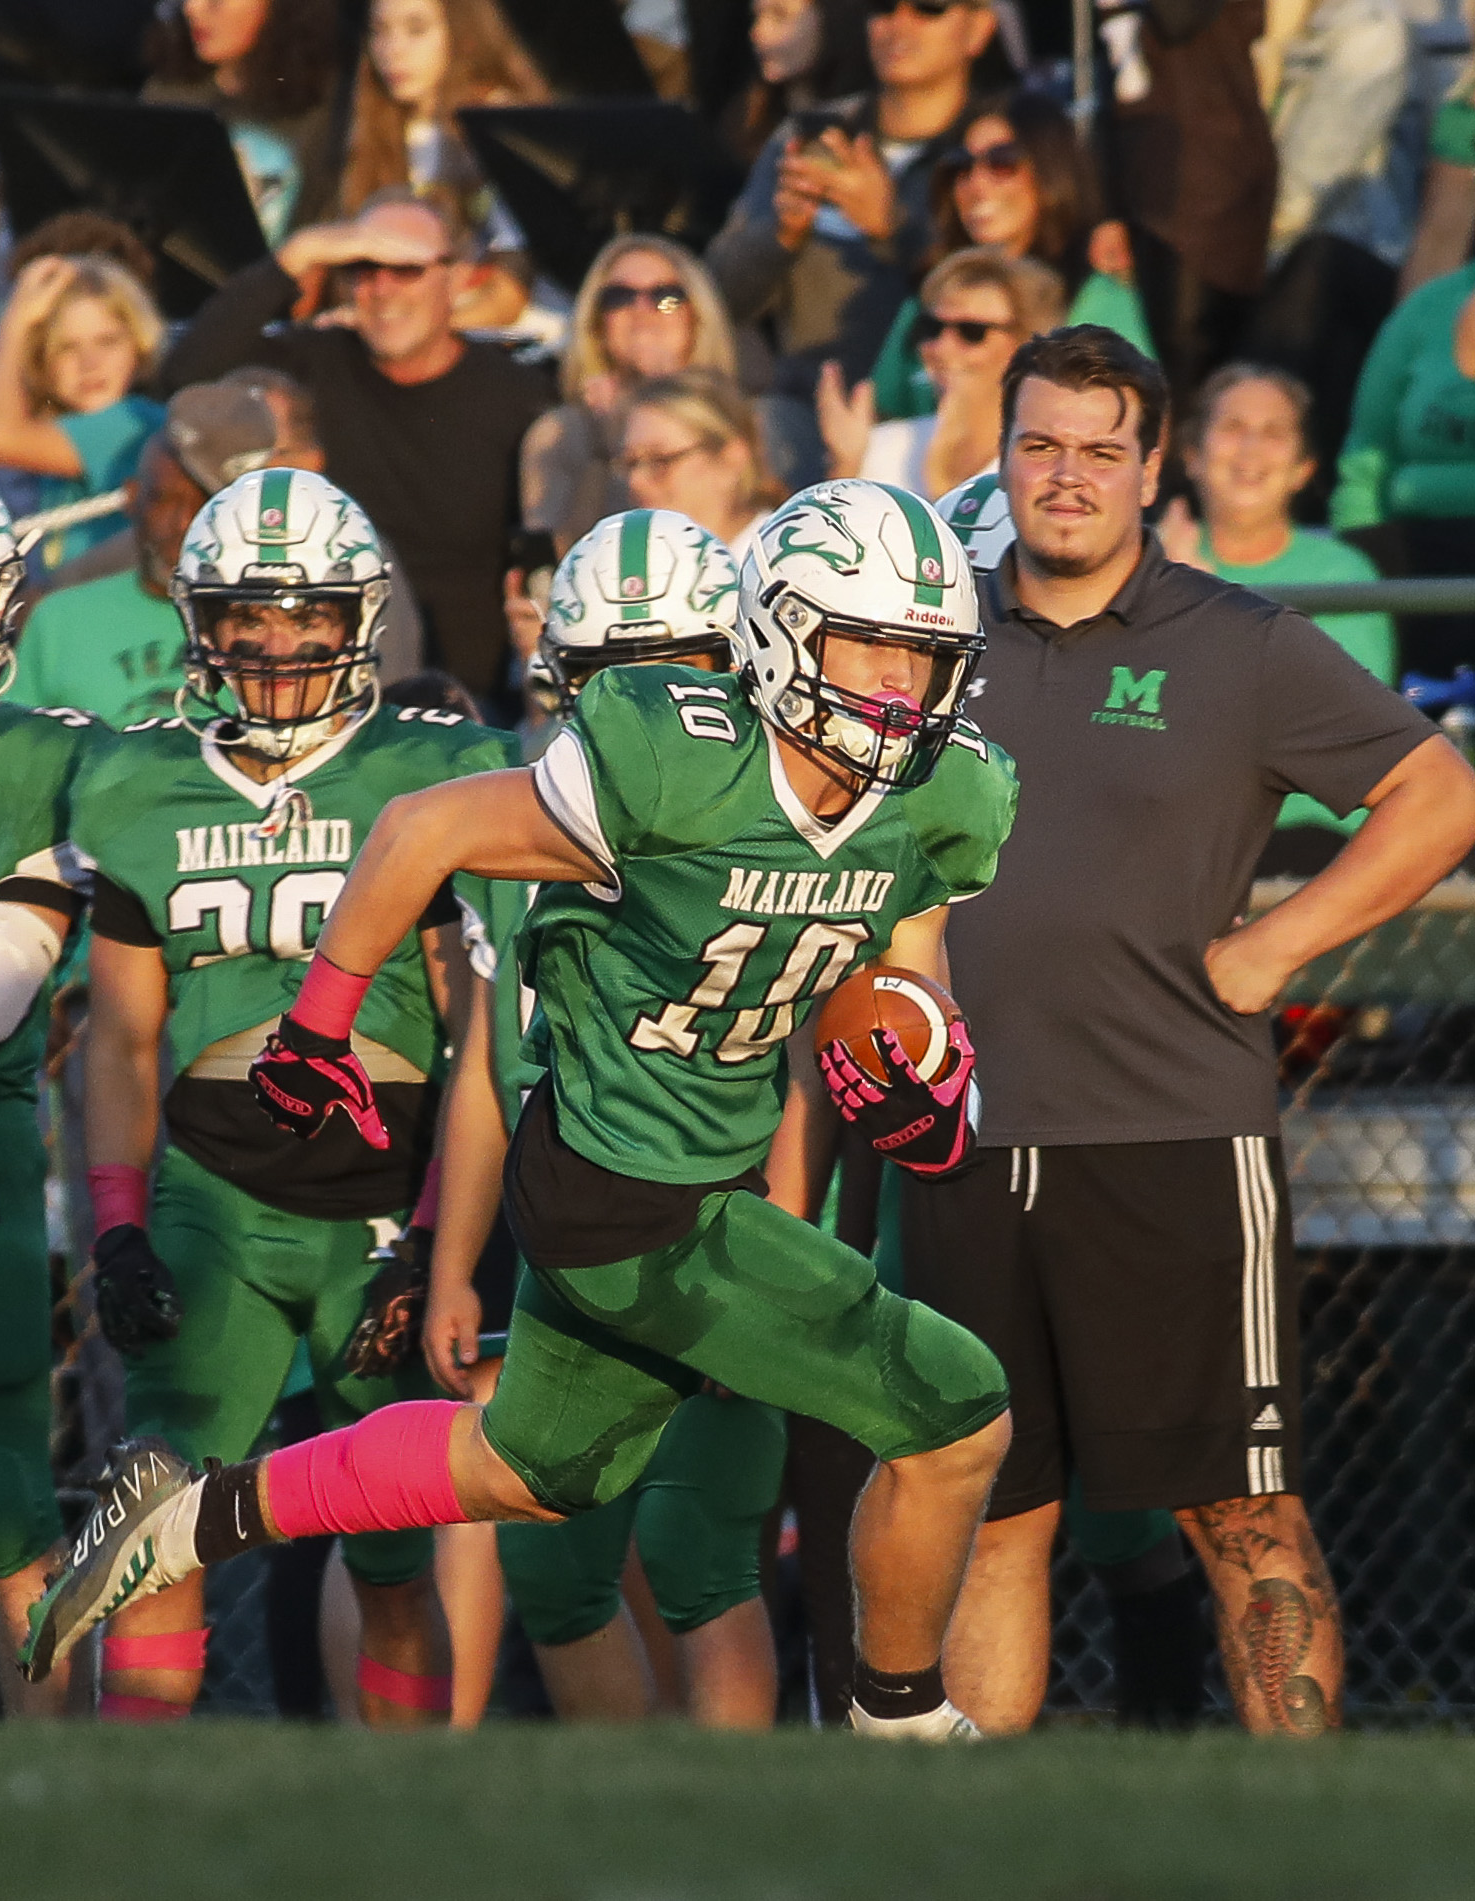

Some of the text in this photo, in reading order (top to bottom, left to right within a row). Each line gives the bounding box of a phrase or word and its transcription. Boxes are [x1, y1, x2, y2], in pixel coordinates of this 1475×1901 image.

[667, 684, 738, 746] 10
[1104, 665, 1169, 714] M
[176, 818, 352, 873] MAINLAND
[719, 867, 895, 915] MAINLAND
[628, 920, 872, 1064] 10
[72, 1450, 171, 1568] VAPOR
